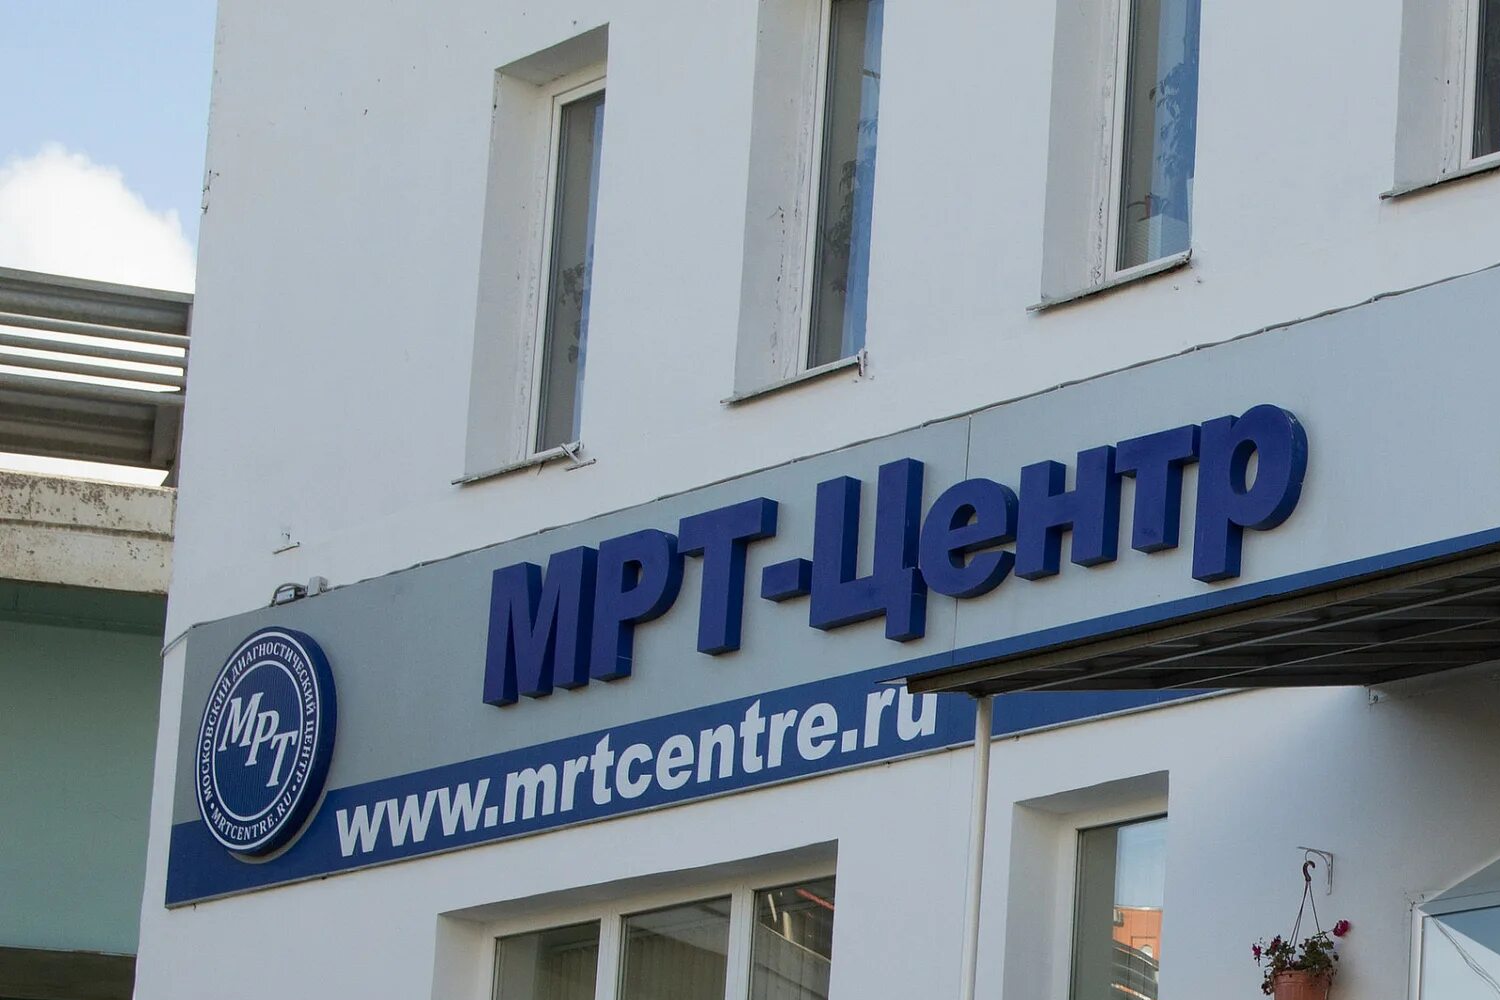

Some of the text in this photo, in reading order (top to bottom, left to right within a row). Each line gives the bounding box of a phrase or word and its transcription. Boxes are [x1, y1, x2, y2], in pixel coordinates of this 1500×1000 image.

[482, 403, 1308, 708] МРТ-Центр
[201, 641, 316, 803] МОСКОВСКИЙ ДИАГНОСТИЧЕСКИЙ ЦЕНТР
[217, 691, 299, 788] МРТ
[336, 684, 938, 858] www.mrtcentre.ru
[210, 791, 292, 842] MRTCENTRE.RU
